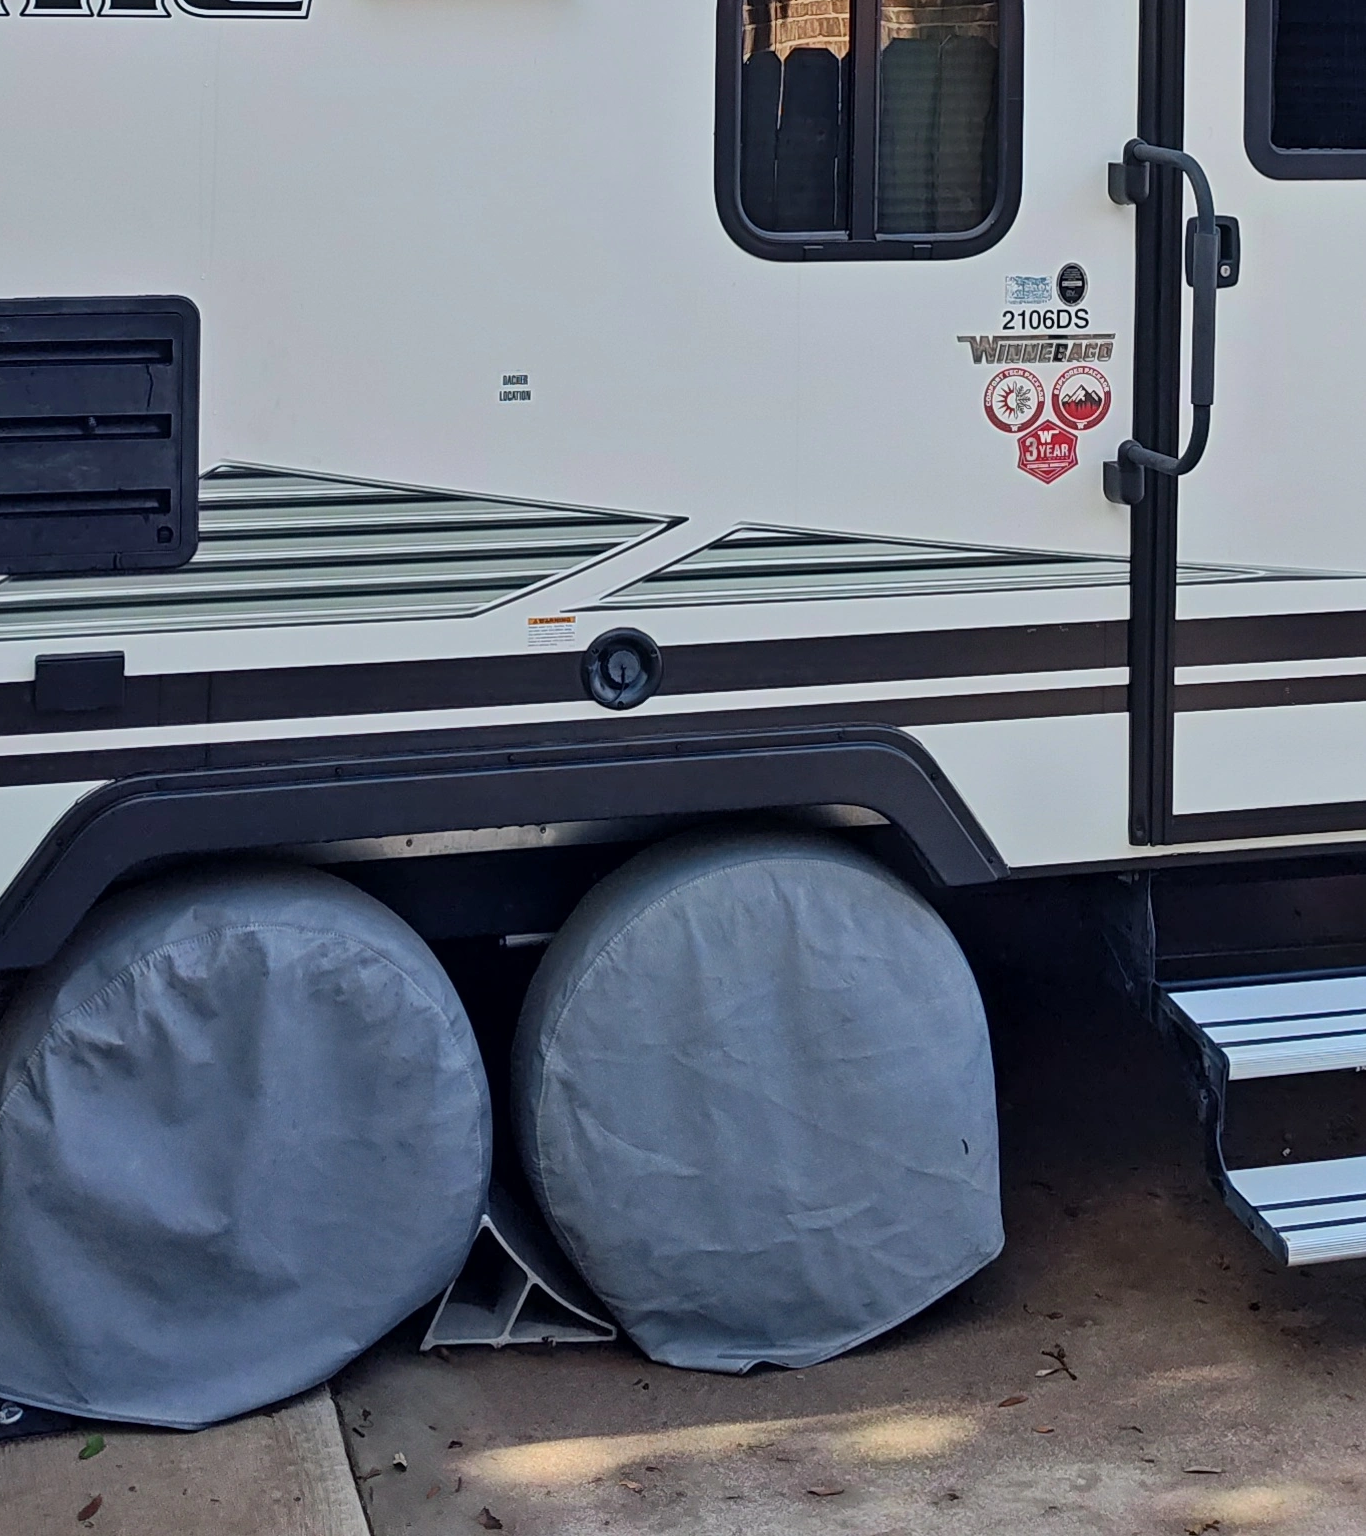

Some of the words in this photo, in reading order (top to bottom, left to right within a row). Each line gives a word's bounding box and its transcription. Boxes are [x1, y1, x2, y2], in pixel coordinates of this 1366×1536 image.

[1002, 308, 1090, 331] 2106DS
[956, 333, 1116, 364] WINNEBAGO
[499, 390, 531, 402] LOCATION
[1025, 437, 1038, 461] 3
[1039, 443, 1069, 458] YEAR
